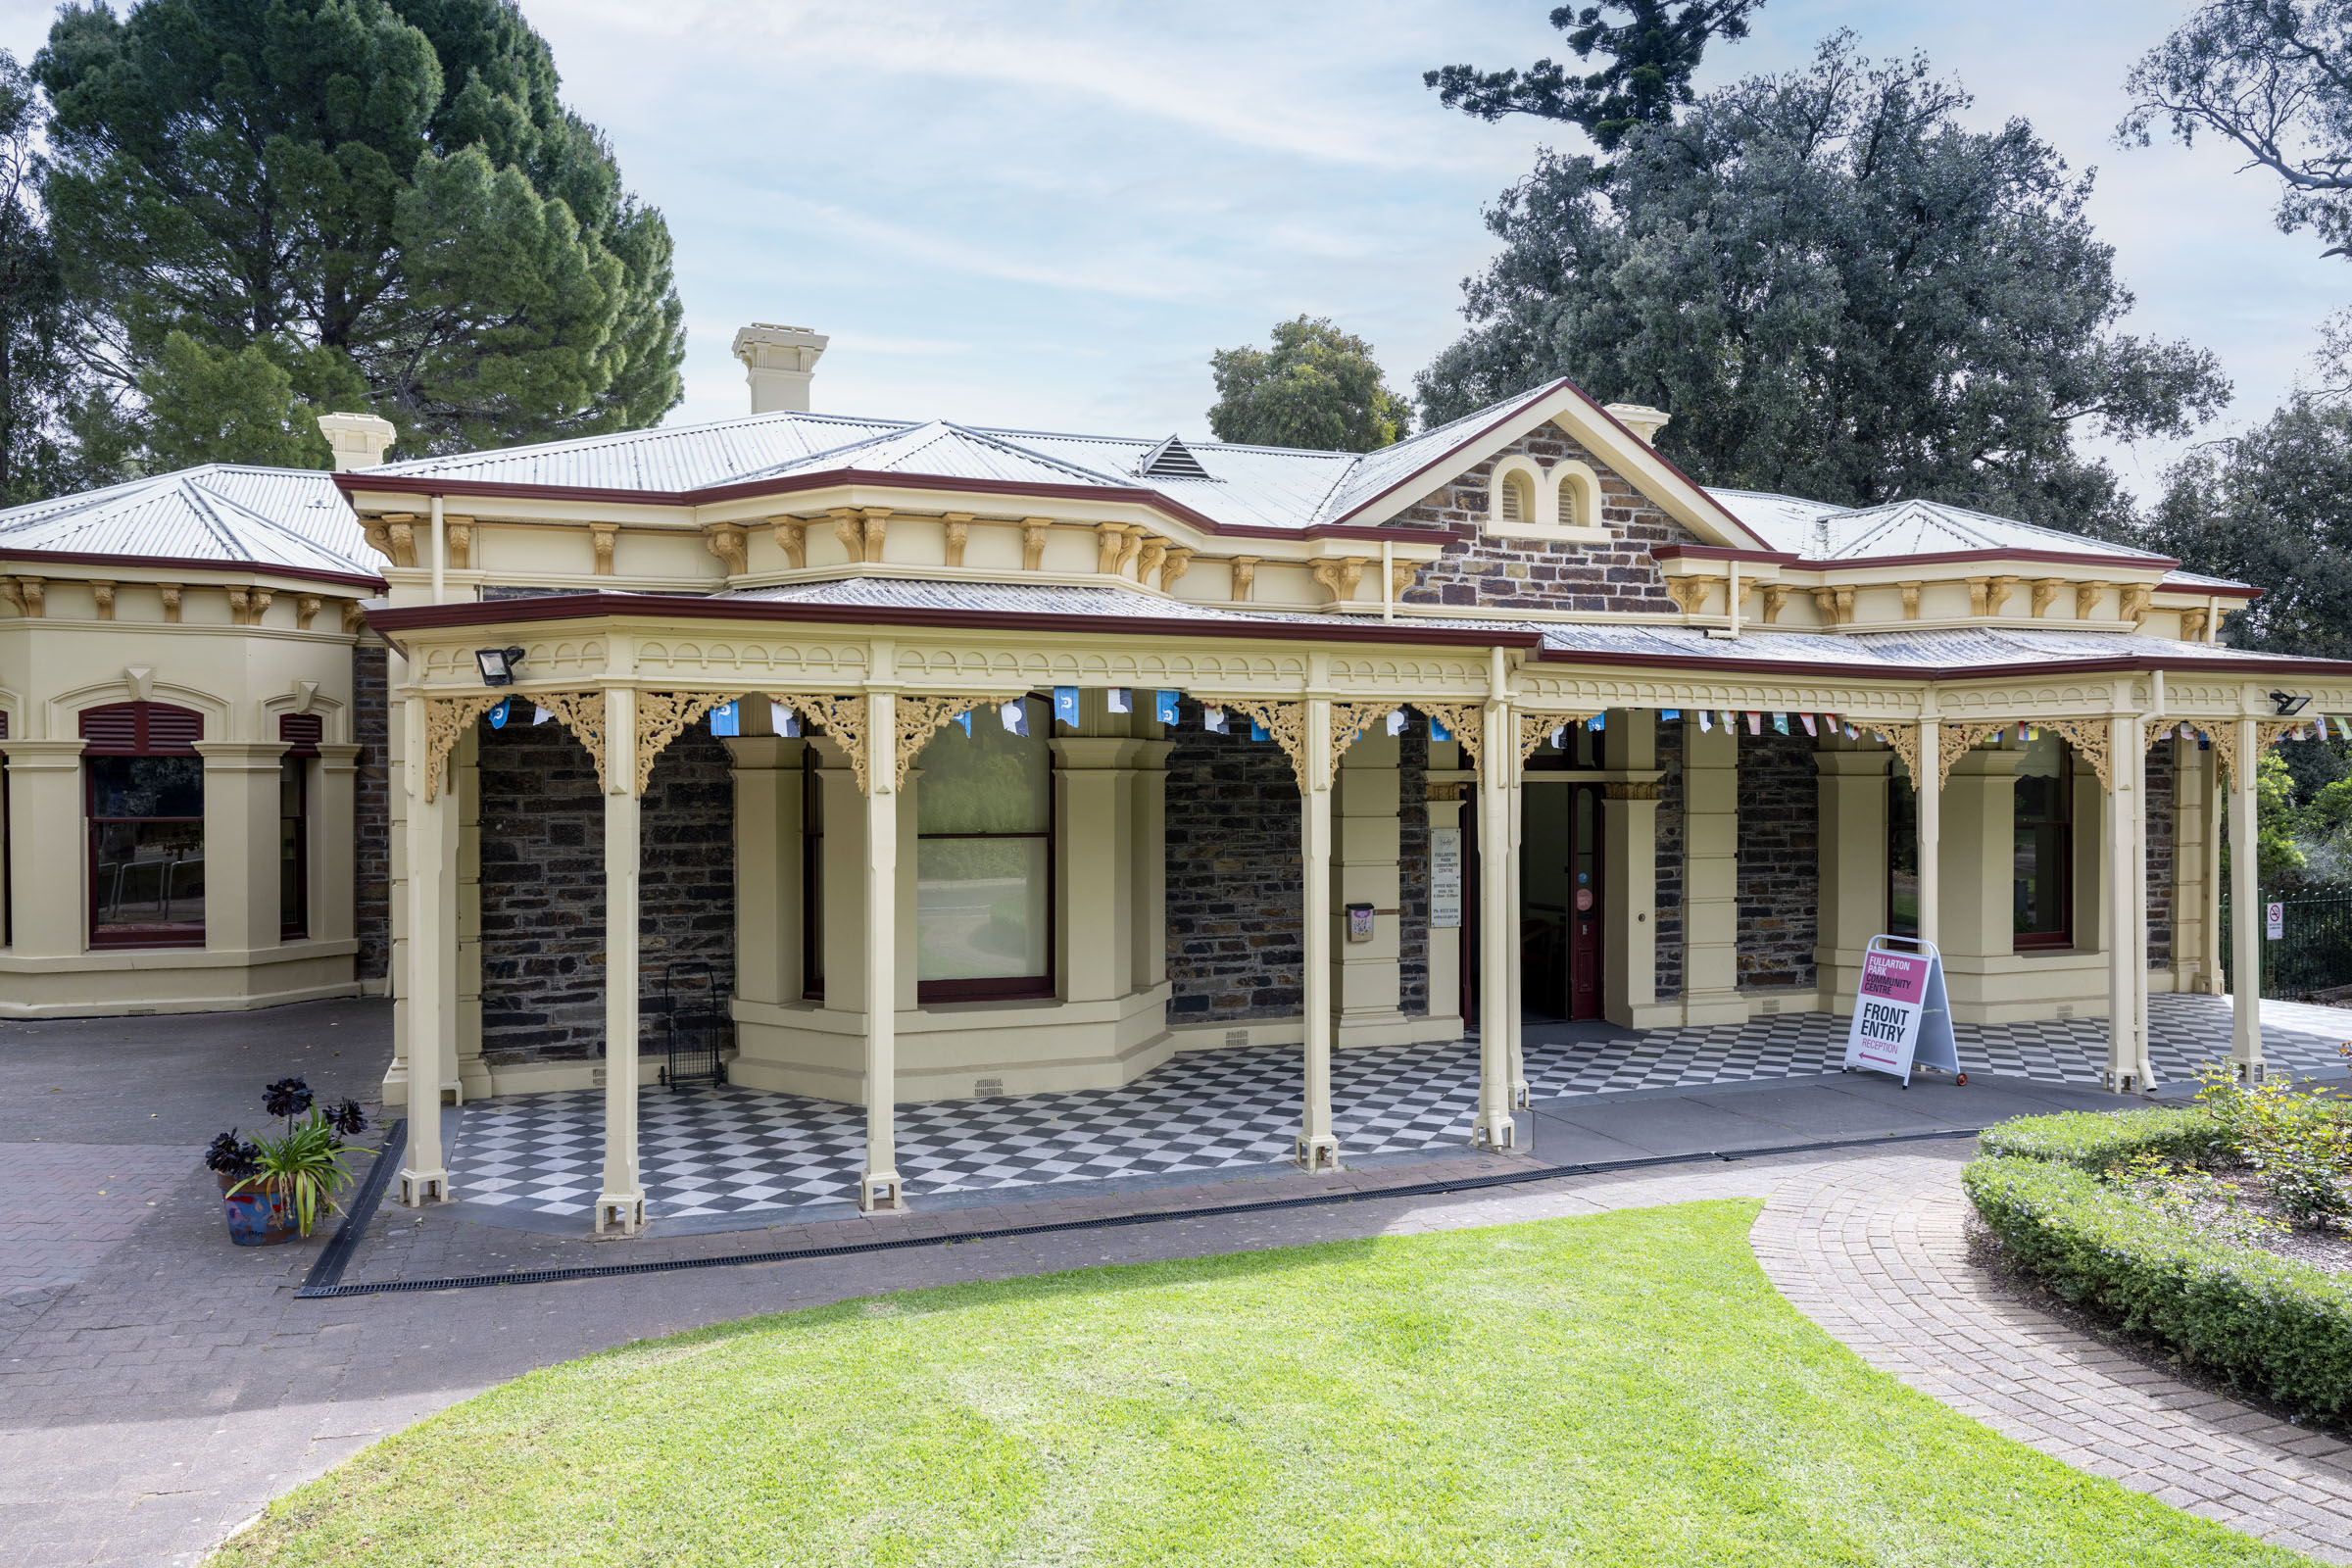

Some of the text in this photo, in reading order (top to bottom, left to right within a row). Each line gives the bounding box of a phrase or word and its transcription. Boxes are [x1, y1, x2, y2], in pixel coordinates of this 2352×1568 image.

[1868, 965, 1886, 976] PARK
[1869, 956, 1910, 971] FULLARTON
[1864, 982, 1892, 995] CENTRE
[1866, 973, 1911, 990] COMMUNITY
[1864, 1002, 1909, 1026] FRONT
[1861, 1019, 1905, 1044] ENTRY
[1862, 1038, 1898, 1054] RECEPTION
